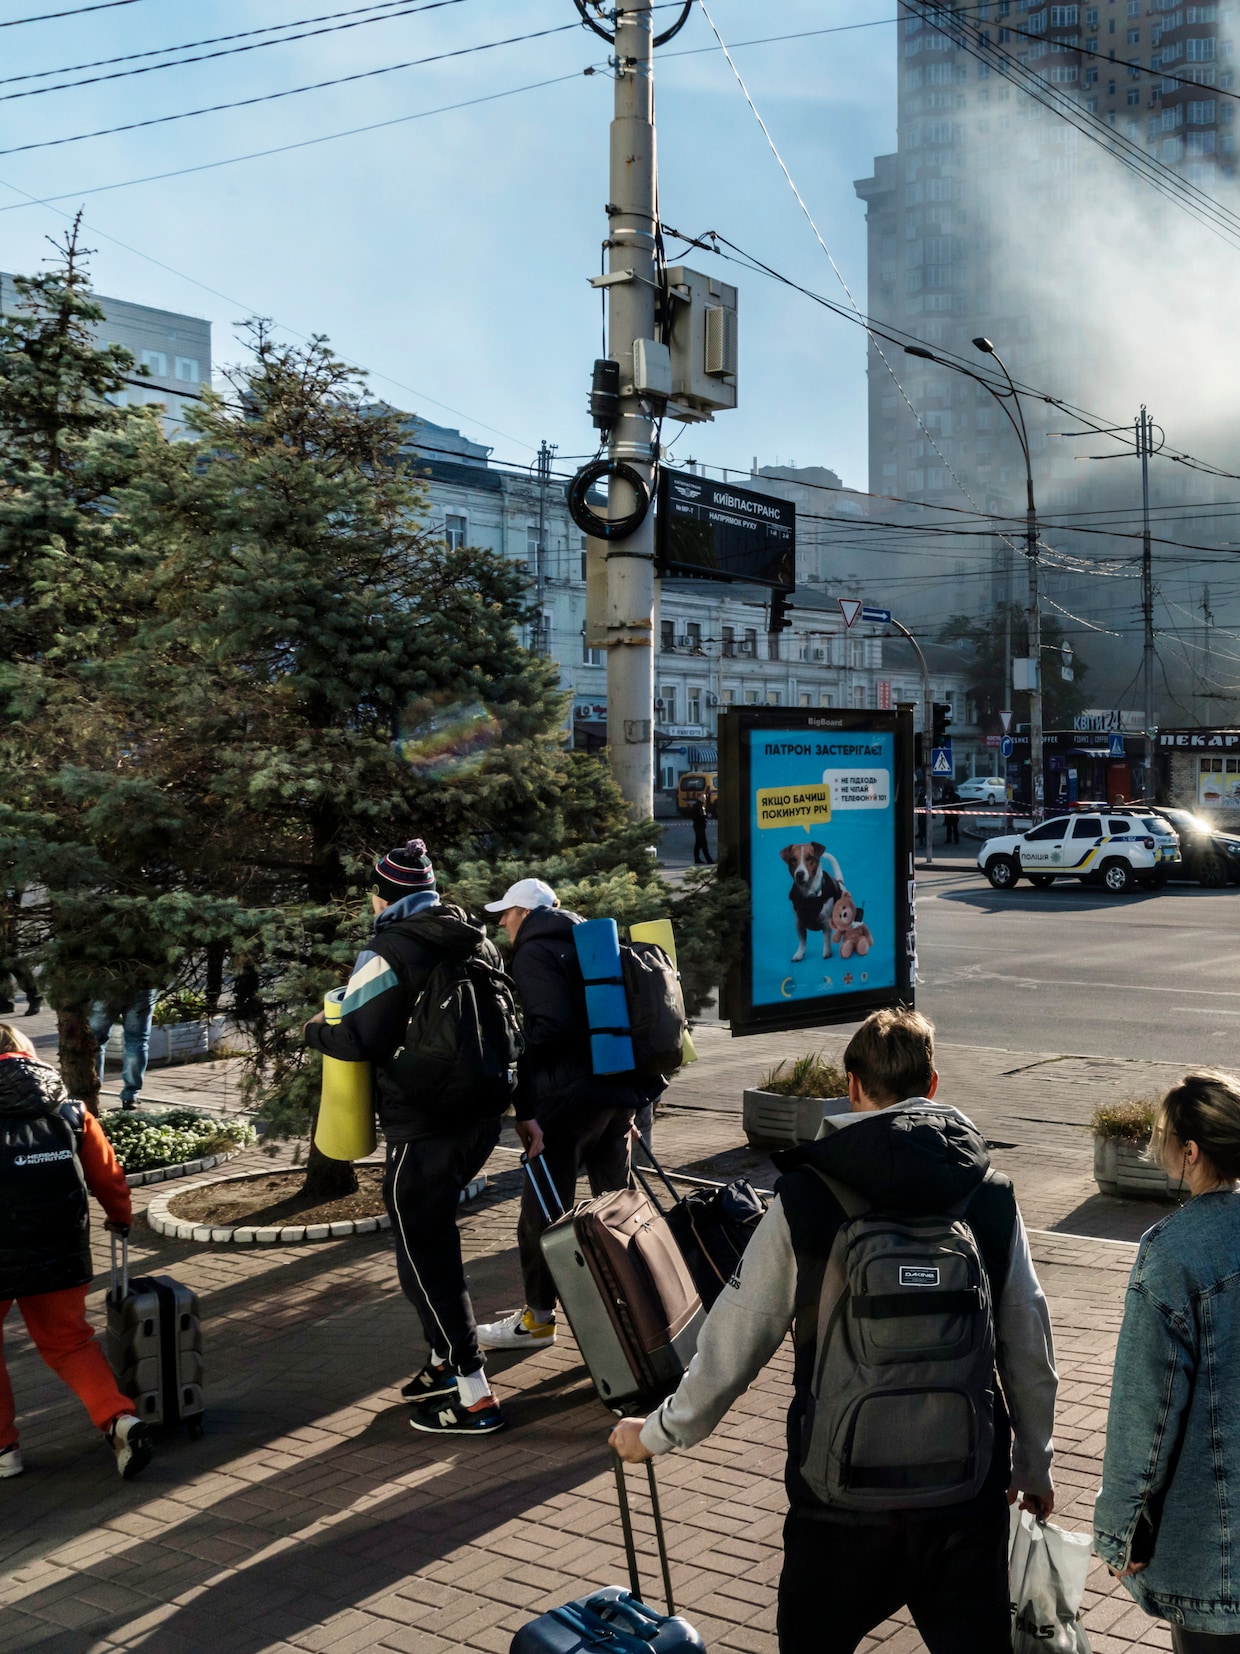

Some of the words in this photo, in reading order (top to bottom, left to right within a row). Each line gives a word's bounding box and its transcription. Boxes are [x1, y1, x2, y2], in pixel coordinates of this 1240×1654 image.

[713, 492, 781, 519] КИЇВПАСТРАНС
[709, 512, 742, 526] НАПРЯМОК
[742, 520, 758, 530] РУХУ
[808, 717, 843, 727] BigBoard
[1073, 715, 1103, 731] КВІТИ
[1104, 710, 1121, 730] 24
[1011, 736, 1029, 744] ISHKI
[764, 744, 811, 756] ПАТРОН
[815, 744, 882, 756] ЗАСТЕРІГАЄ!
[850, 777, 877, 785] ПІДХОДЬ
[849, 785, 868, 793] ЧІПАЙ
[761, 795, 791, 807] ЯКЩО
[793, 792, 826, 804] БАЧИШ
[841, 793, 877, 802] ТЕЛЕФОНУЙ
[762, 806, 812, 820] ПОКИНУТУ
[814, 804, 828, 815] РІЧ
[27, 1149, 72, 1160] HERBALIFE
[27, 1154, 73, 1165] NUTRITION
[419, 1371, 434, 1388] N
[438, 1408, 458, 1427] N
